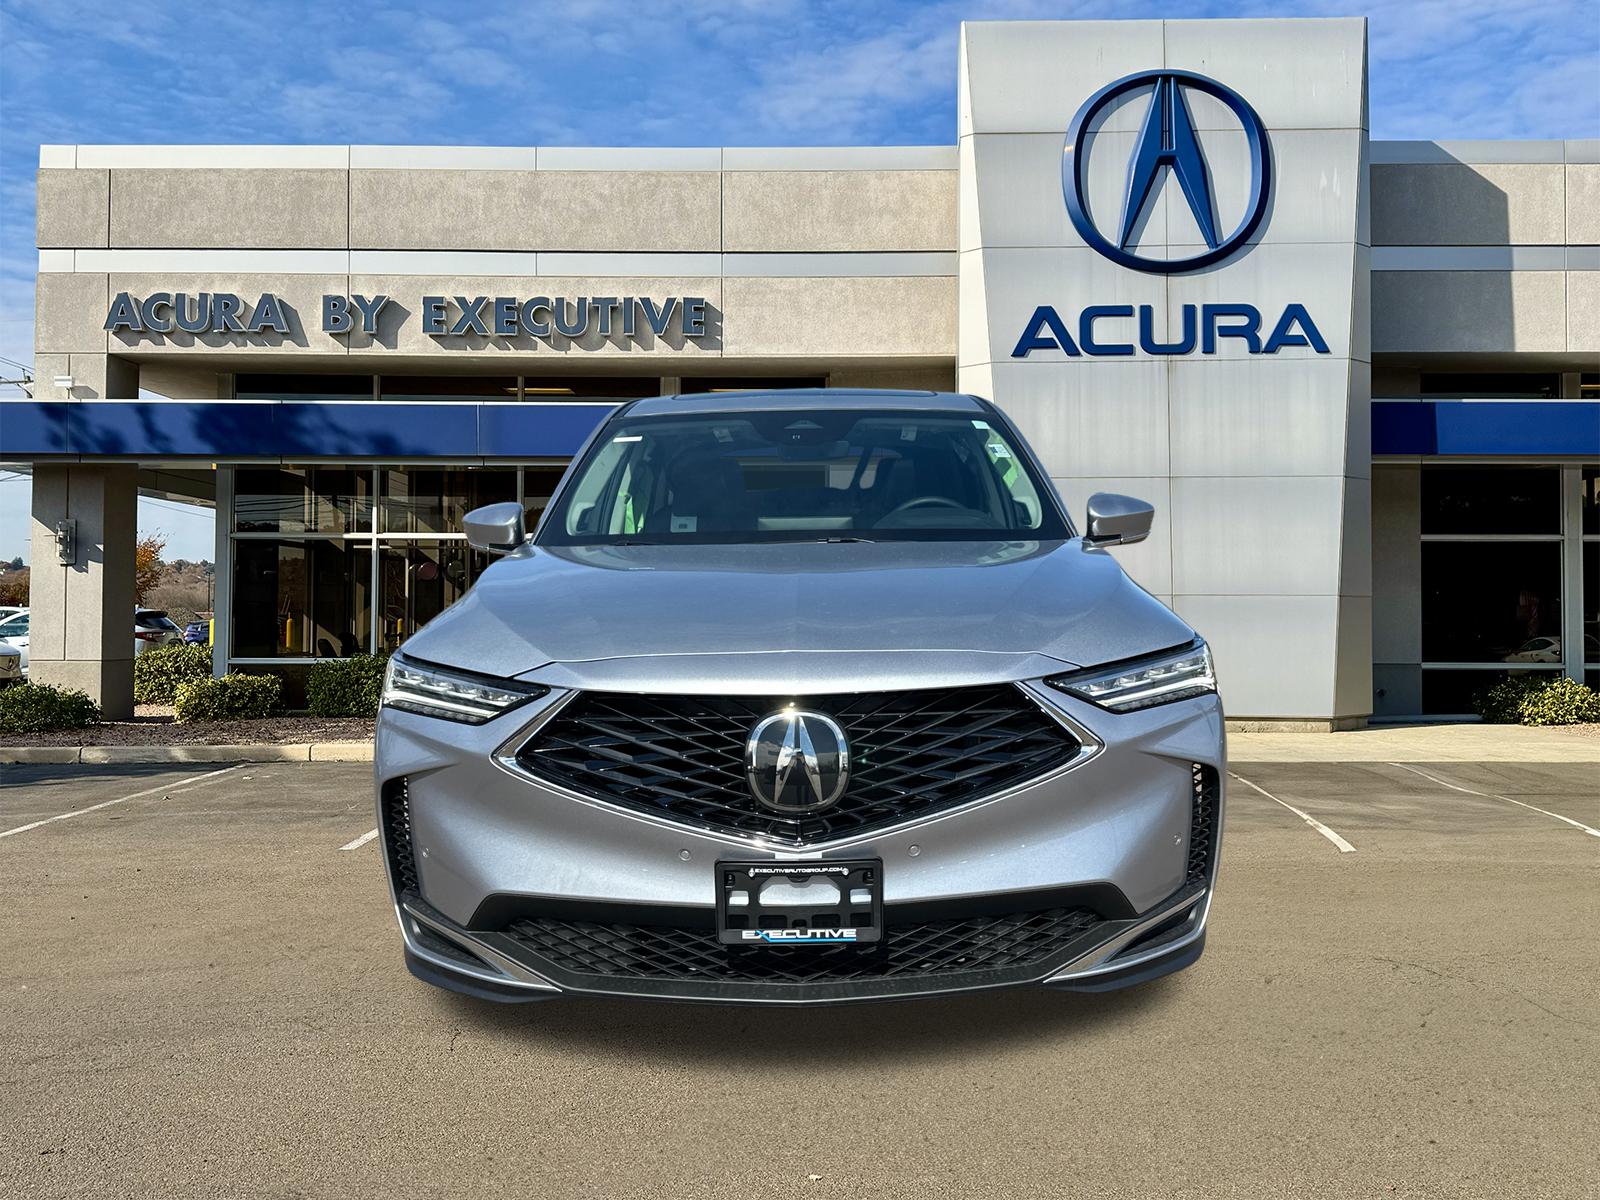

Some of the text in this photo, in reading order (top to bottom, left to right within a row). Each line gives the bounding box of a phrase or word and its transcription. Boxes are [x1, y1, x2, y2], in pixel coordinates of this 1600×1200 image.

[104, 292, 706, 337] ACURA BY EXECUTIVE
[1011, 303, 1332, 357] ACURA
[742, 929, 857, 941] EXECUTIVE
